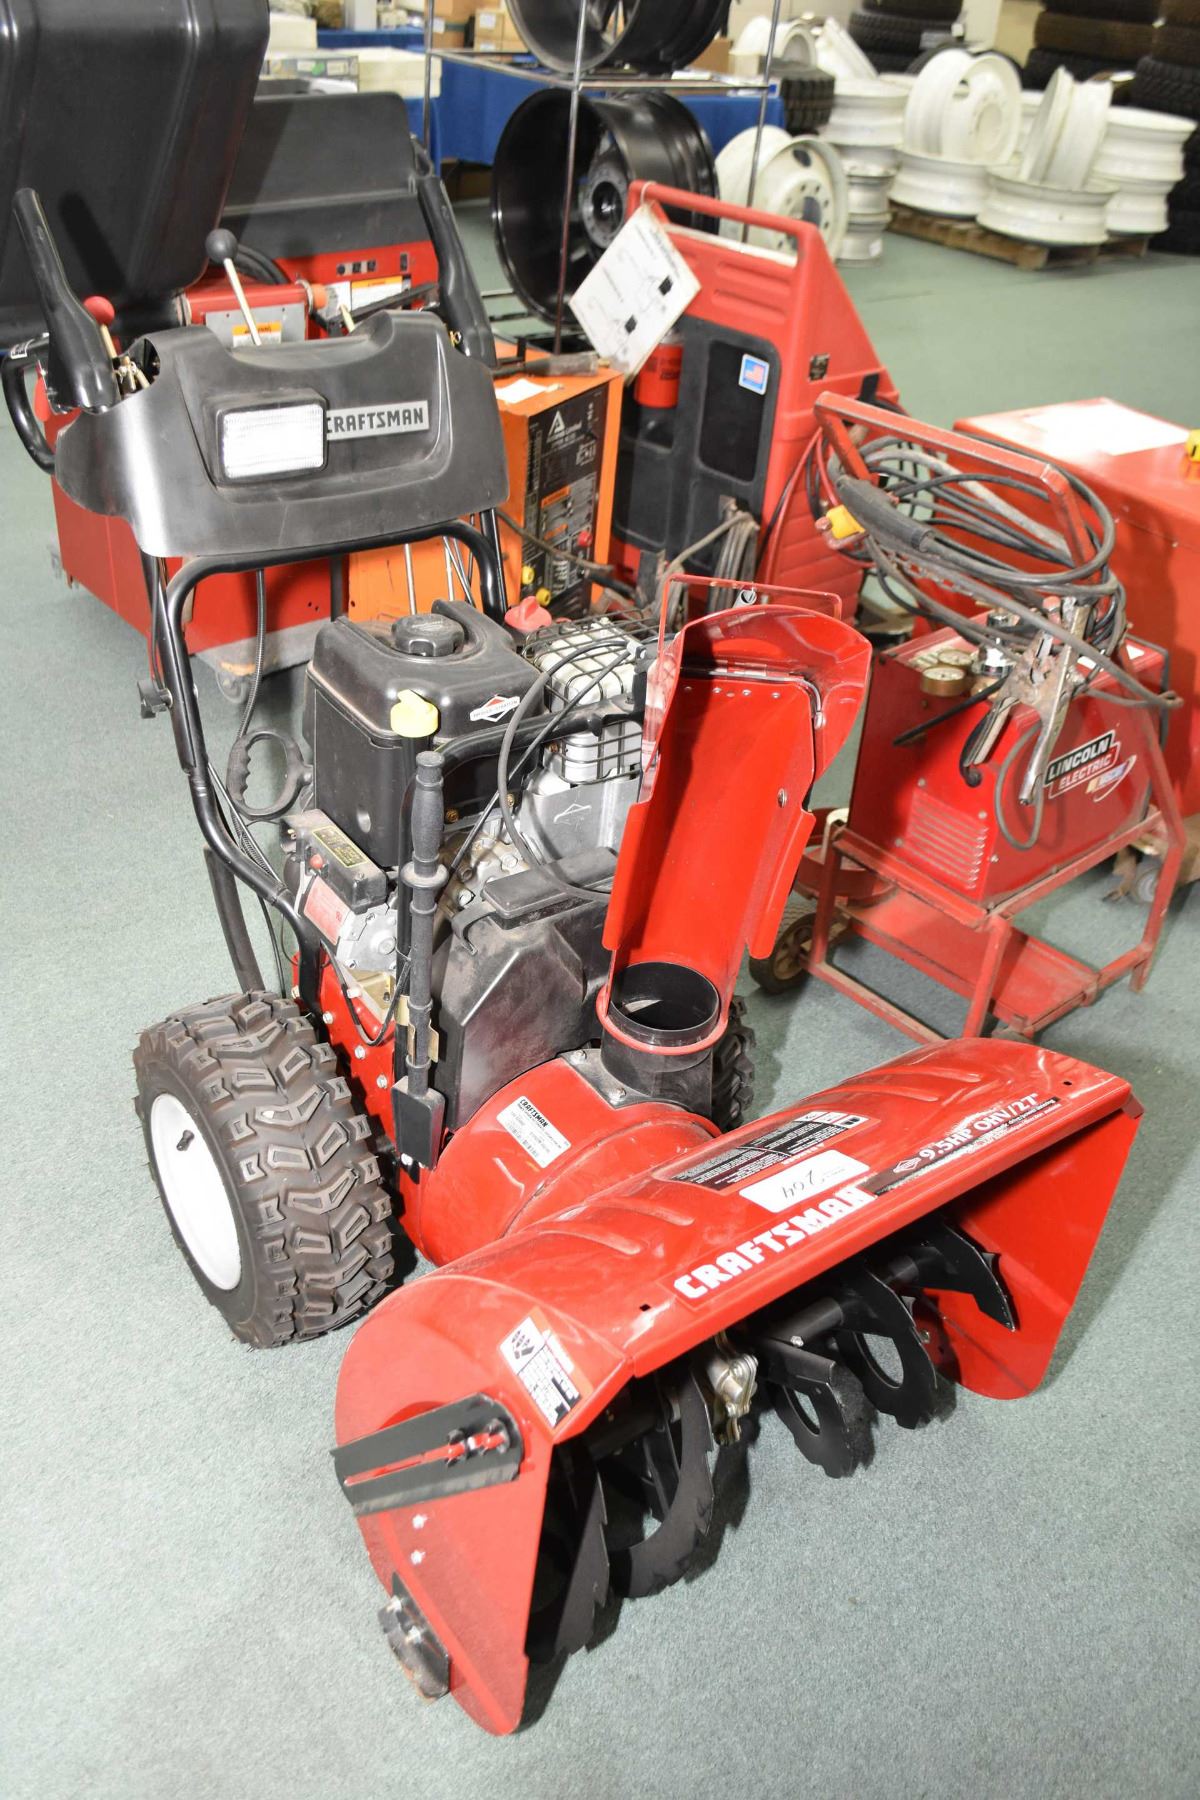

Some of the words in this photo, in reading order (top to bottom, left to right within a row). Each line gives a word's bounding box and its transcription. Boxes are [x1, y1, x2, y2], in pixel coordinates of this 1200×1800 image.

[1047, 737, 1111, 781] LINCOLN
[1058, 753, 1113, 790] ELECTRIC
[520, 1098, 549, 1128] CRAFTSMAN
[919, 1128, 974, 1161] 9.5HP
[673, 1186, 878, 1299] CRAFTSMAN
